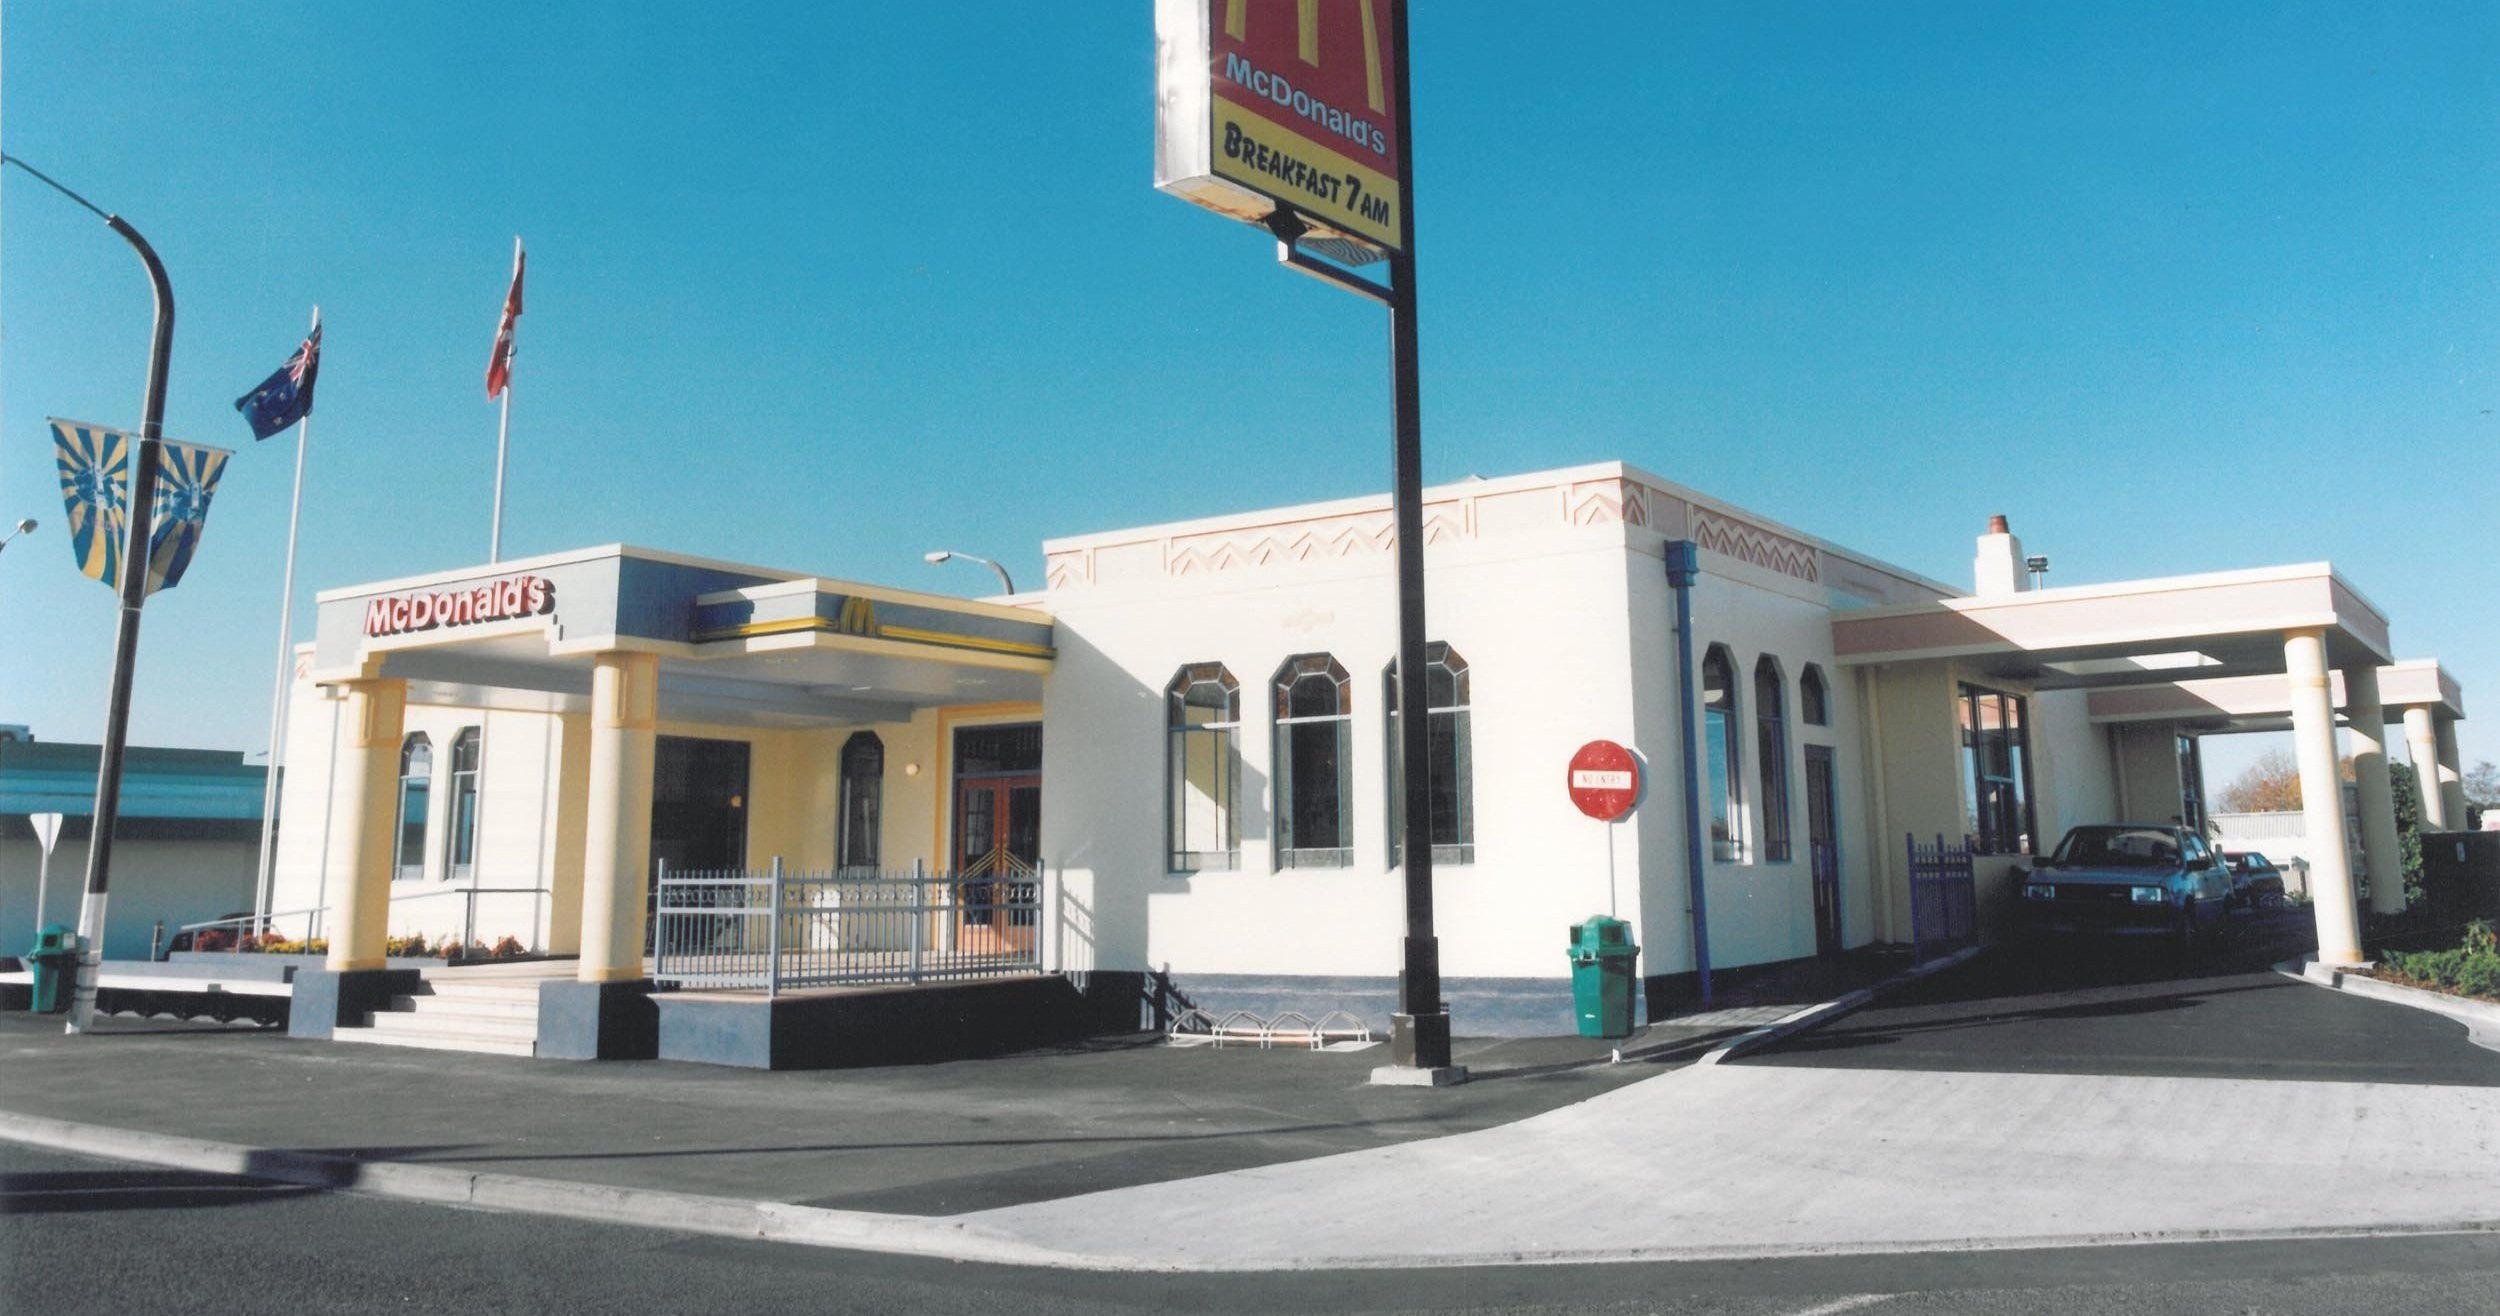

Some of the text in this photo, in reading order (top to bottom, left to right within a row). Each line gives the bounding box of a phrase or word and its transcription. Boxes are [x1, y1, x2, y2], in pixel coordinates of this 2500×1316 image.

[1225, 51, 1386, 155] McDonald's
[1223, 120, 1389, 227] BREAKFAST 7 AM
[364, 575, 546, 636] McDonald's
